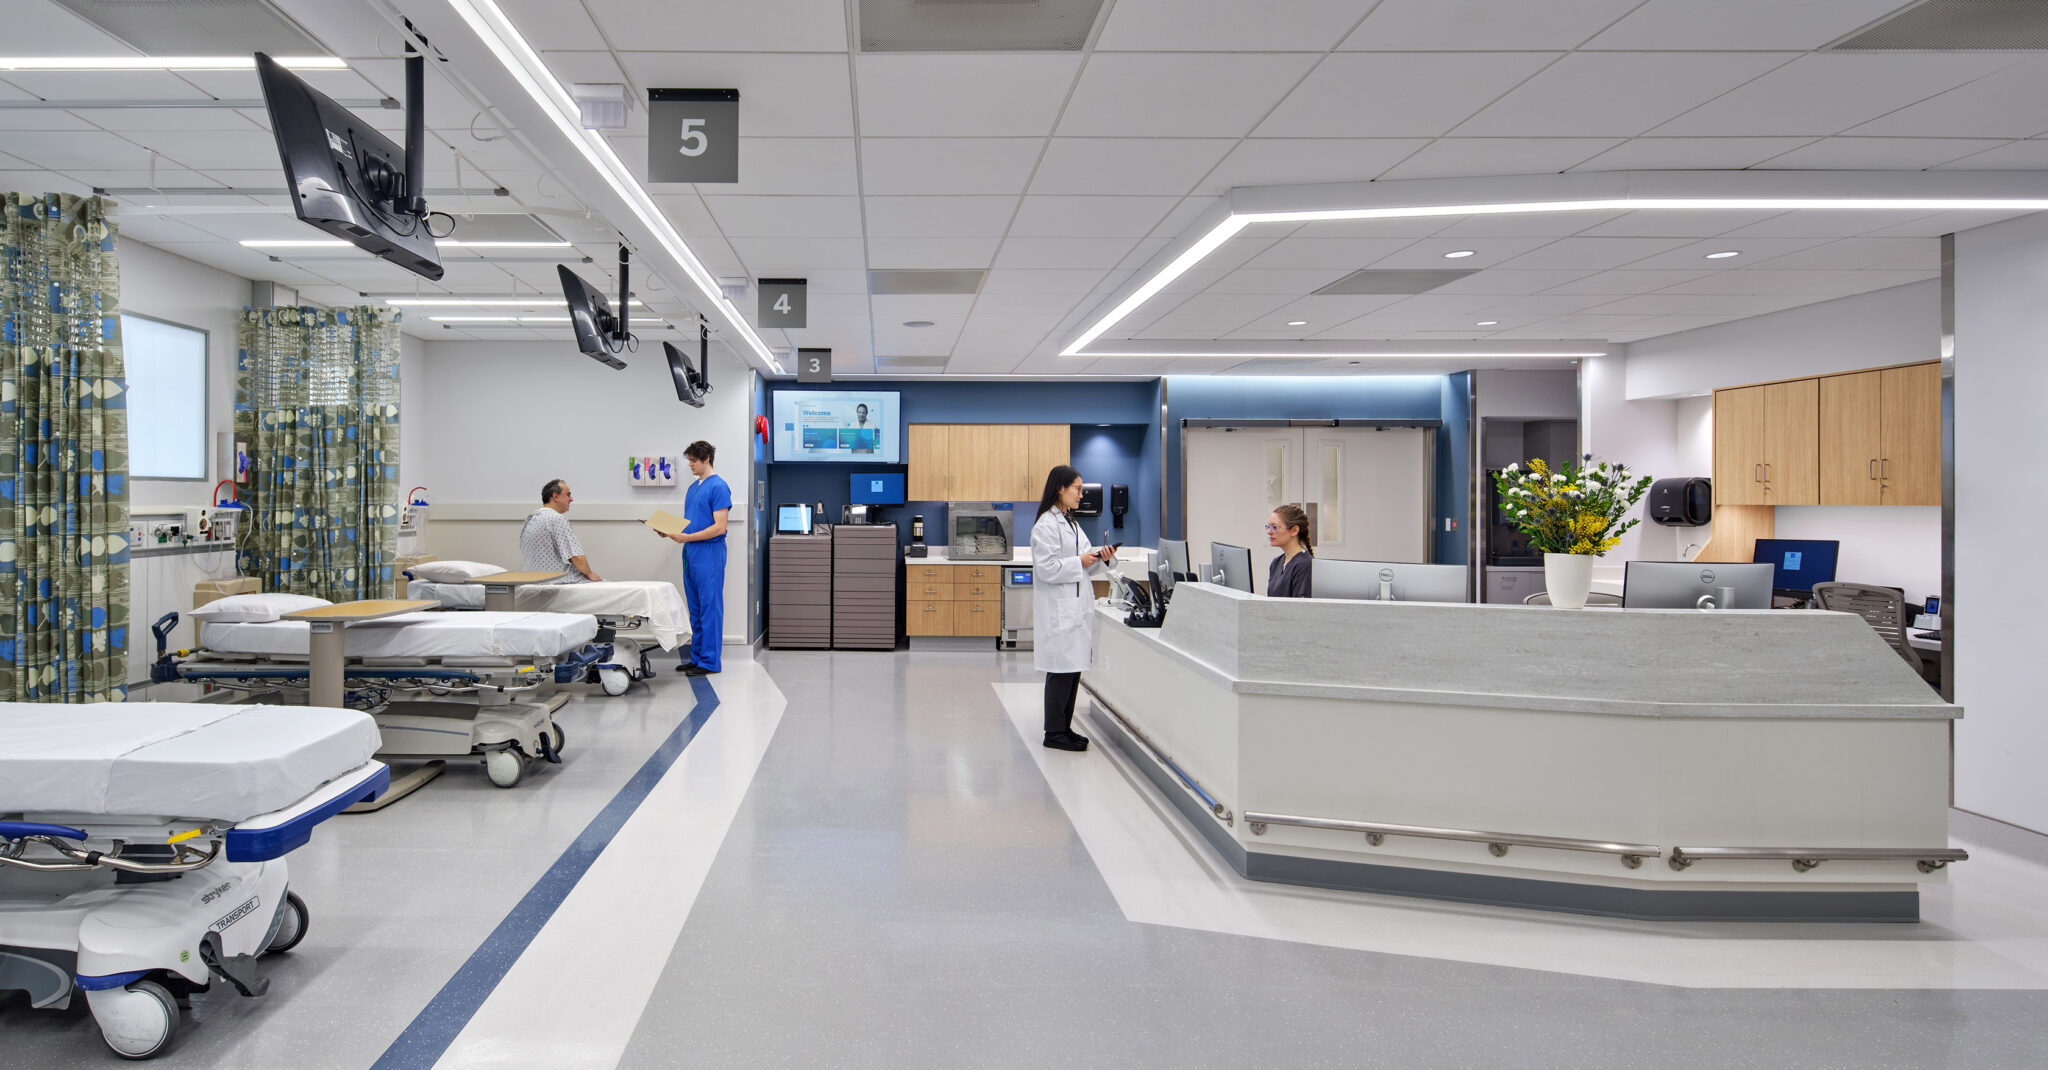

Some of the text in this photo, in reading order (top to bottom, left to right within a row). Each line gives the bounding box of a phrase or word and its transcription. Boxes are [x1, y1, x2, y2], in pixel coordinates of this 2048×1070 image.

[679, 118, 708, 157] 5
[773, 293, 792, 315] 4
[808, 358, 821, 373] 3
[201, 882, 232, 905] stryker
[216, 901, 255, 930] TRANSPORT
